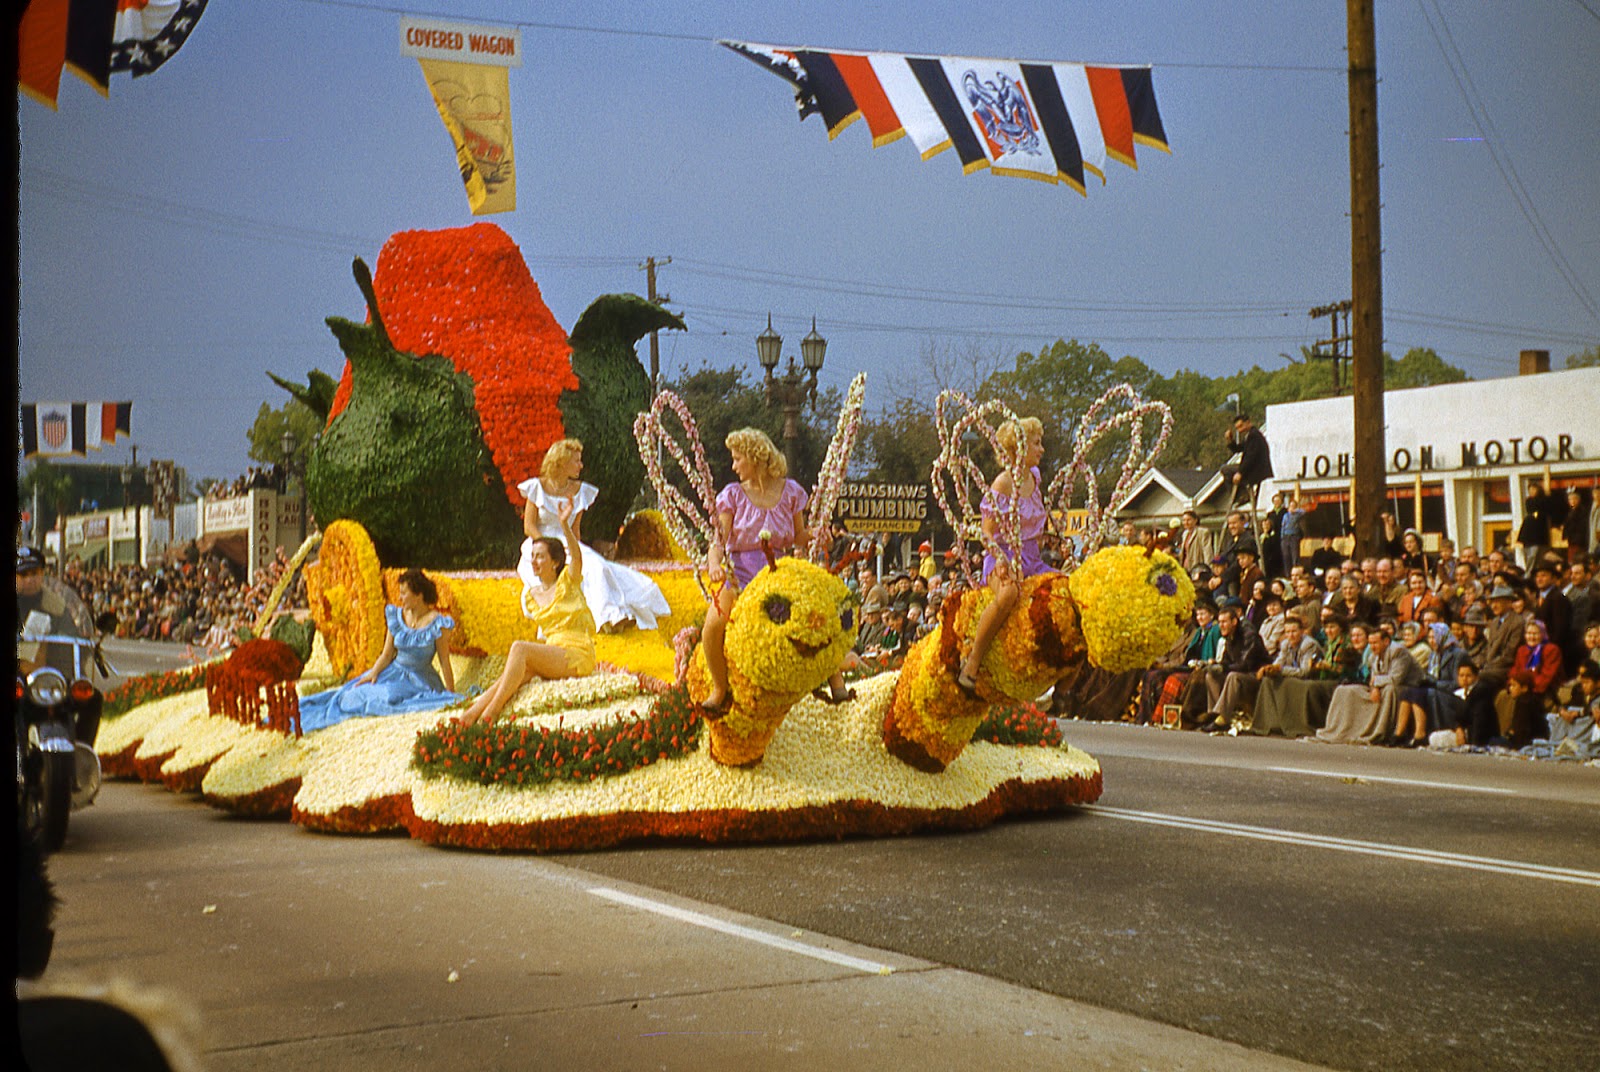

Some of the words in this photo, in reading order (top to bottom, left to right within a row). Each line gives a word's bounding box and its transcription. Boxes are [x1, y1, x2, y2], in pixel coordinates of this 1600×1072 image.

[407, 28, 463, 50] COVERED
[469, 33, 515, 56] WAGON
[1296, 445, 1433, 479] JOHON
[1461, 433, 1575, 468] MOTOR
[840, 483, 928, 499] BRADSHAWS
[838, 500, 928, 519] PLUMBING
[851, 522, 914, 530] APPLIANCES
